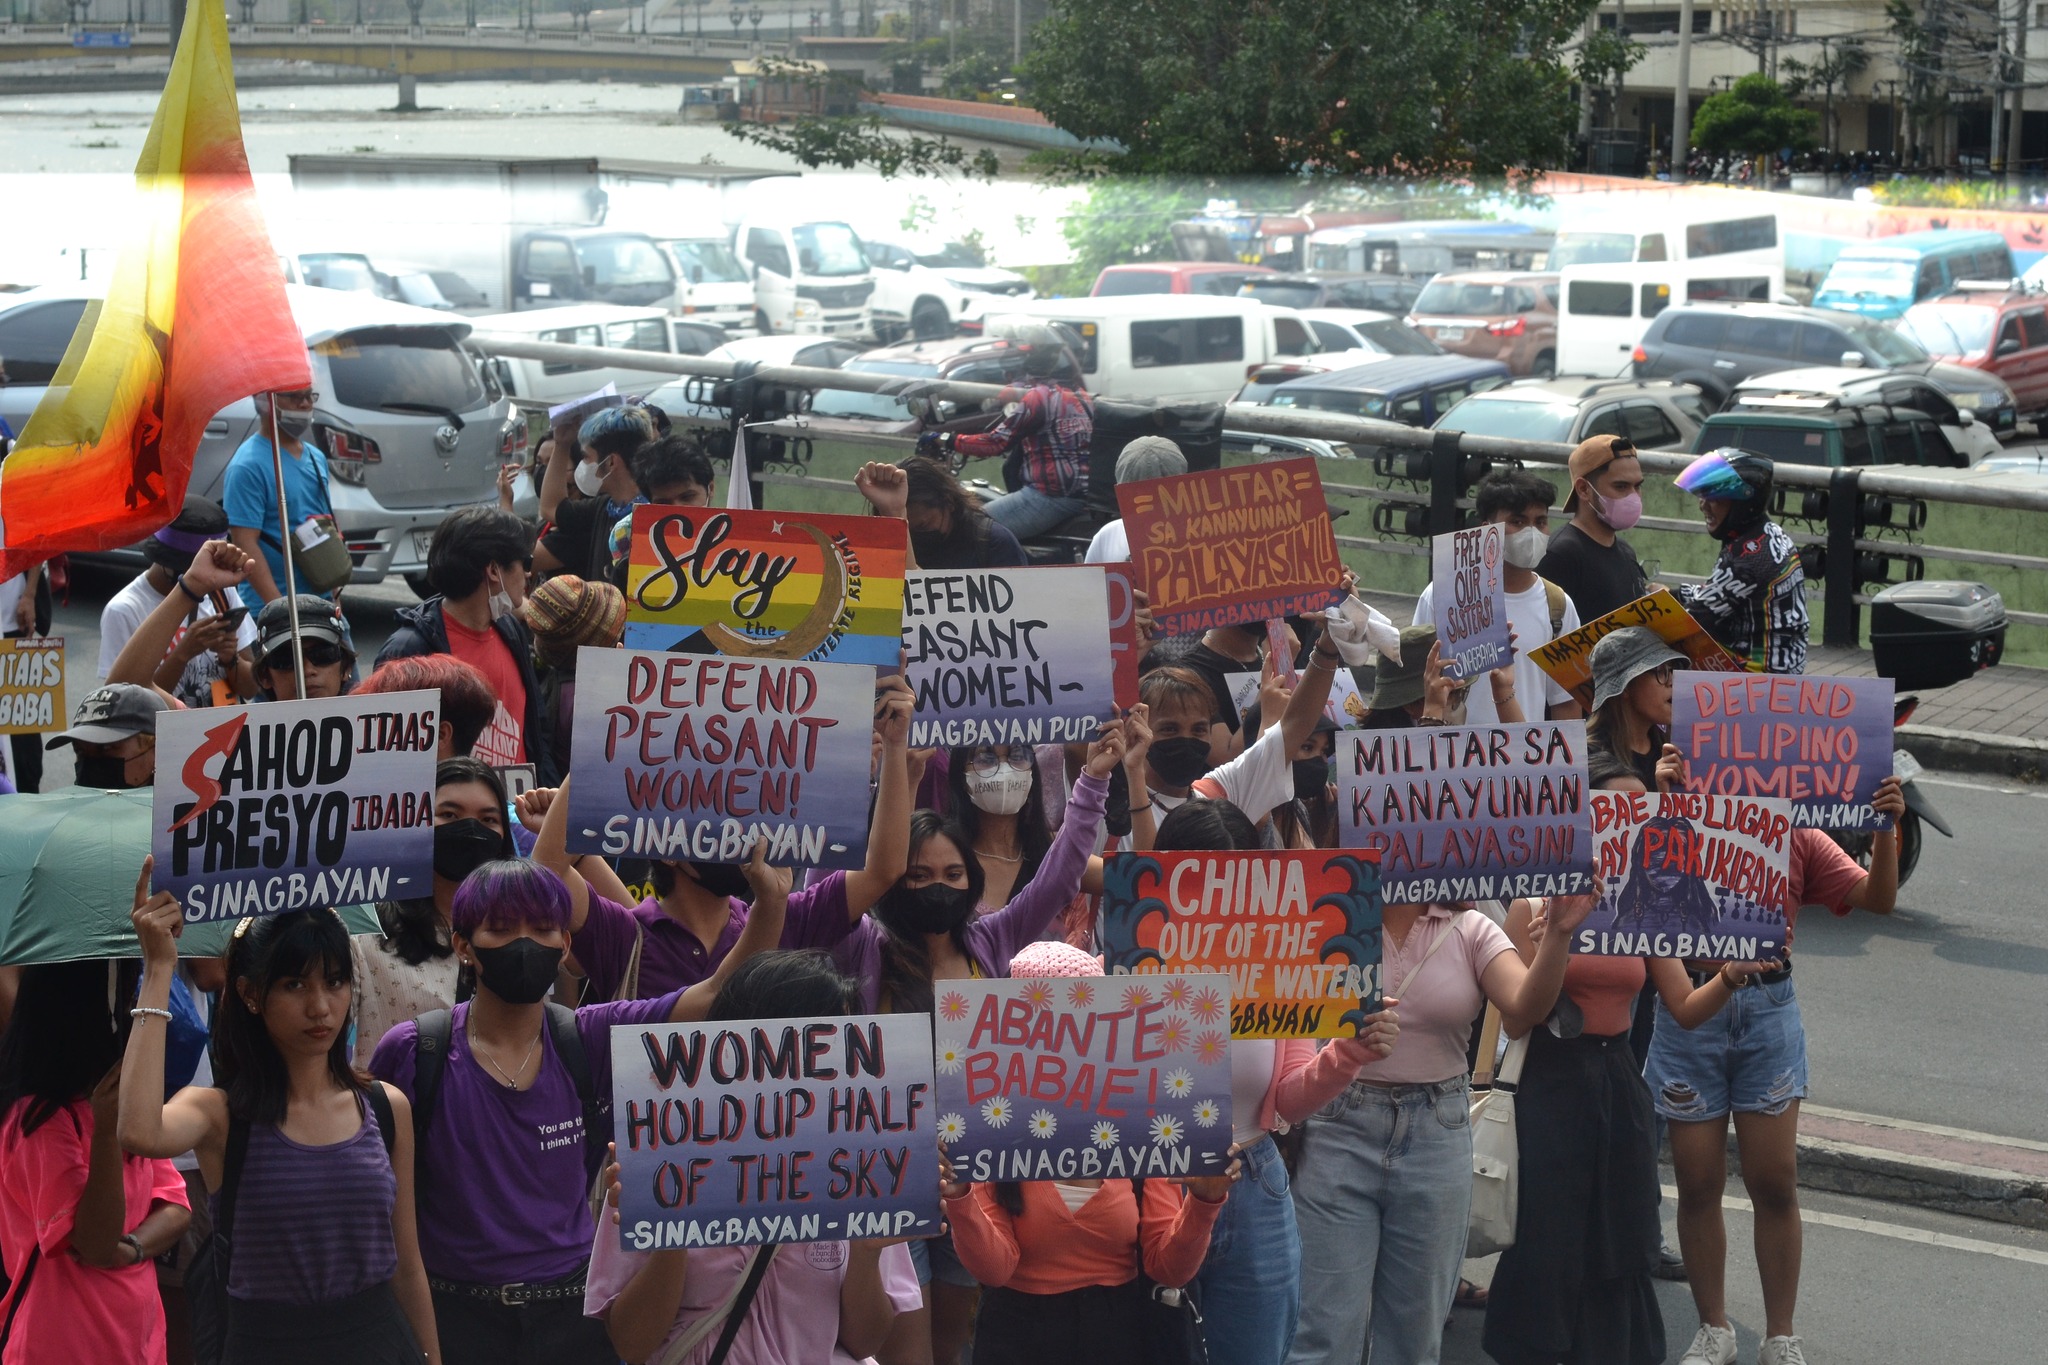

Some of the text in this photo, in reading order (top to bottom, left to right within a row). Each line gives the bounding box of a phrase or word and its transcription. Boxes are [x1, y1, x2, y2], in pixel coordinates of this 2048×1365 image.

[1148, 499, 1301, 545] SA KANAYUNAN
[634, 513, 797, 619] Slay
[832, 530, 862, 601] REGIME
[1143, 512, 1340, 609] PALAYASIN!
[1453, 529, 1482, 570] FREE
[1455, 566, 1482, 608] OUR
[745, 621, 777, 636] the
[1447, 596, 1494, 644] SISTERS!
[1541, 598, 1671, 667] MARCOS JR.
[628, 655, 818, 715] DEFEND
[1693, 676, 1857, 719] DEFEND
[356, 711, 435, 754] ITAAS
[605, 705, 839, 772] PEASANT
[1353, 727, 1573, 776] MILITAR SA
[1691, 721, 1859, 763] FILIPINO
[624, 767, 800, 819] WOMEN!
[1352, 774, 1582, 827] KANAYUNAN
[1682, 759, 1861, 803] WOMEN!
[173, 790, 434, 877] PRESYO IBABA
[1366, 824, 1575, 872] PALAYASIN!
[1657, 792, 1702, 820] ANG
[1699, 794, 1790, 854] LUGAR
[1600, 830, 1630, 879] AY
[1169, 858, 1308, 917] CHINA
[1158, 920, 1325, 961] OUT OF THE
[1274, 963, 1382, 1001] WATERS!
[967, 993, 1165, 1063] ABANTE
[641, 1022, 886, 1089] WOMEN
[965, 1051, 1157, 1118] BABAE!
[538, 1124, 557, 1134] You
[559, 1120, 573, 1130] are
[626, 1083, 928, 1150] HOLD UP HALF
[540, 1142, 544, 1151] I
[547, 1136, 571, 1150] think
[653, 1146, 911, 1210] OF THE SKY
